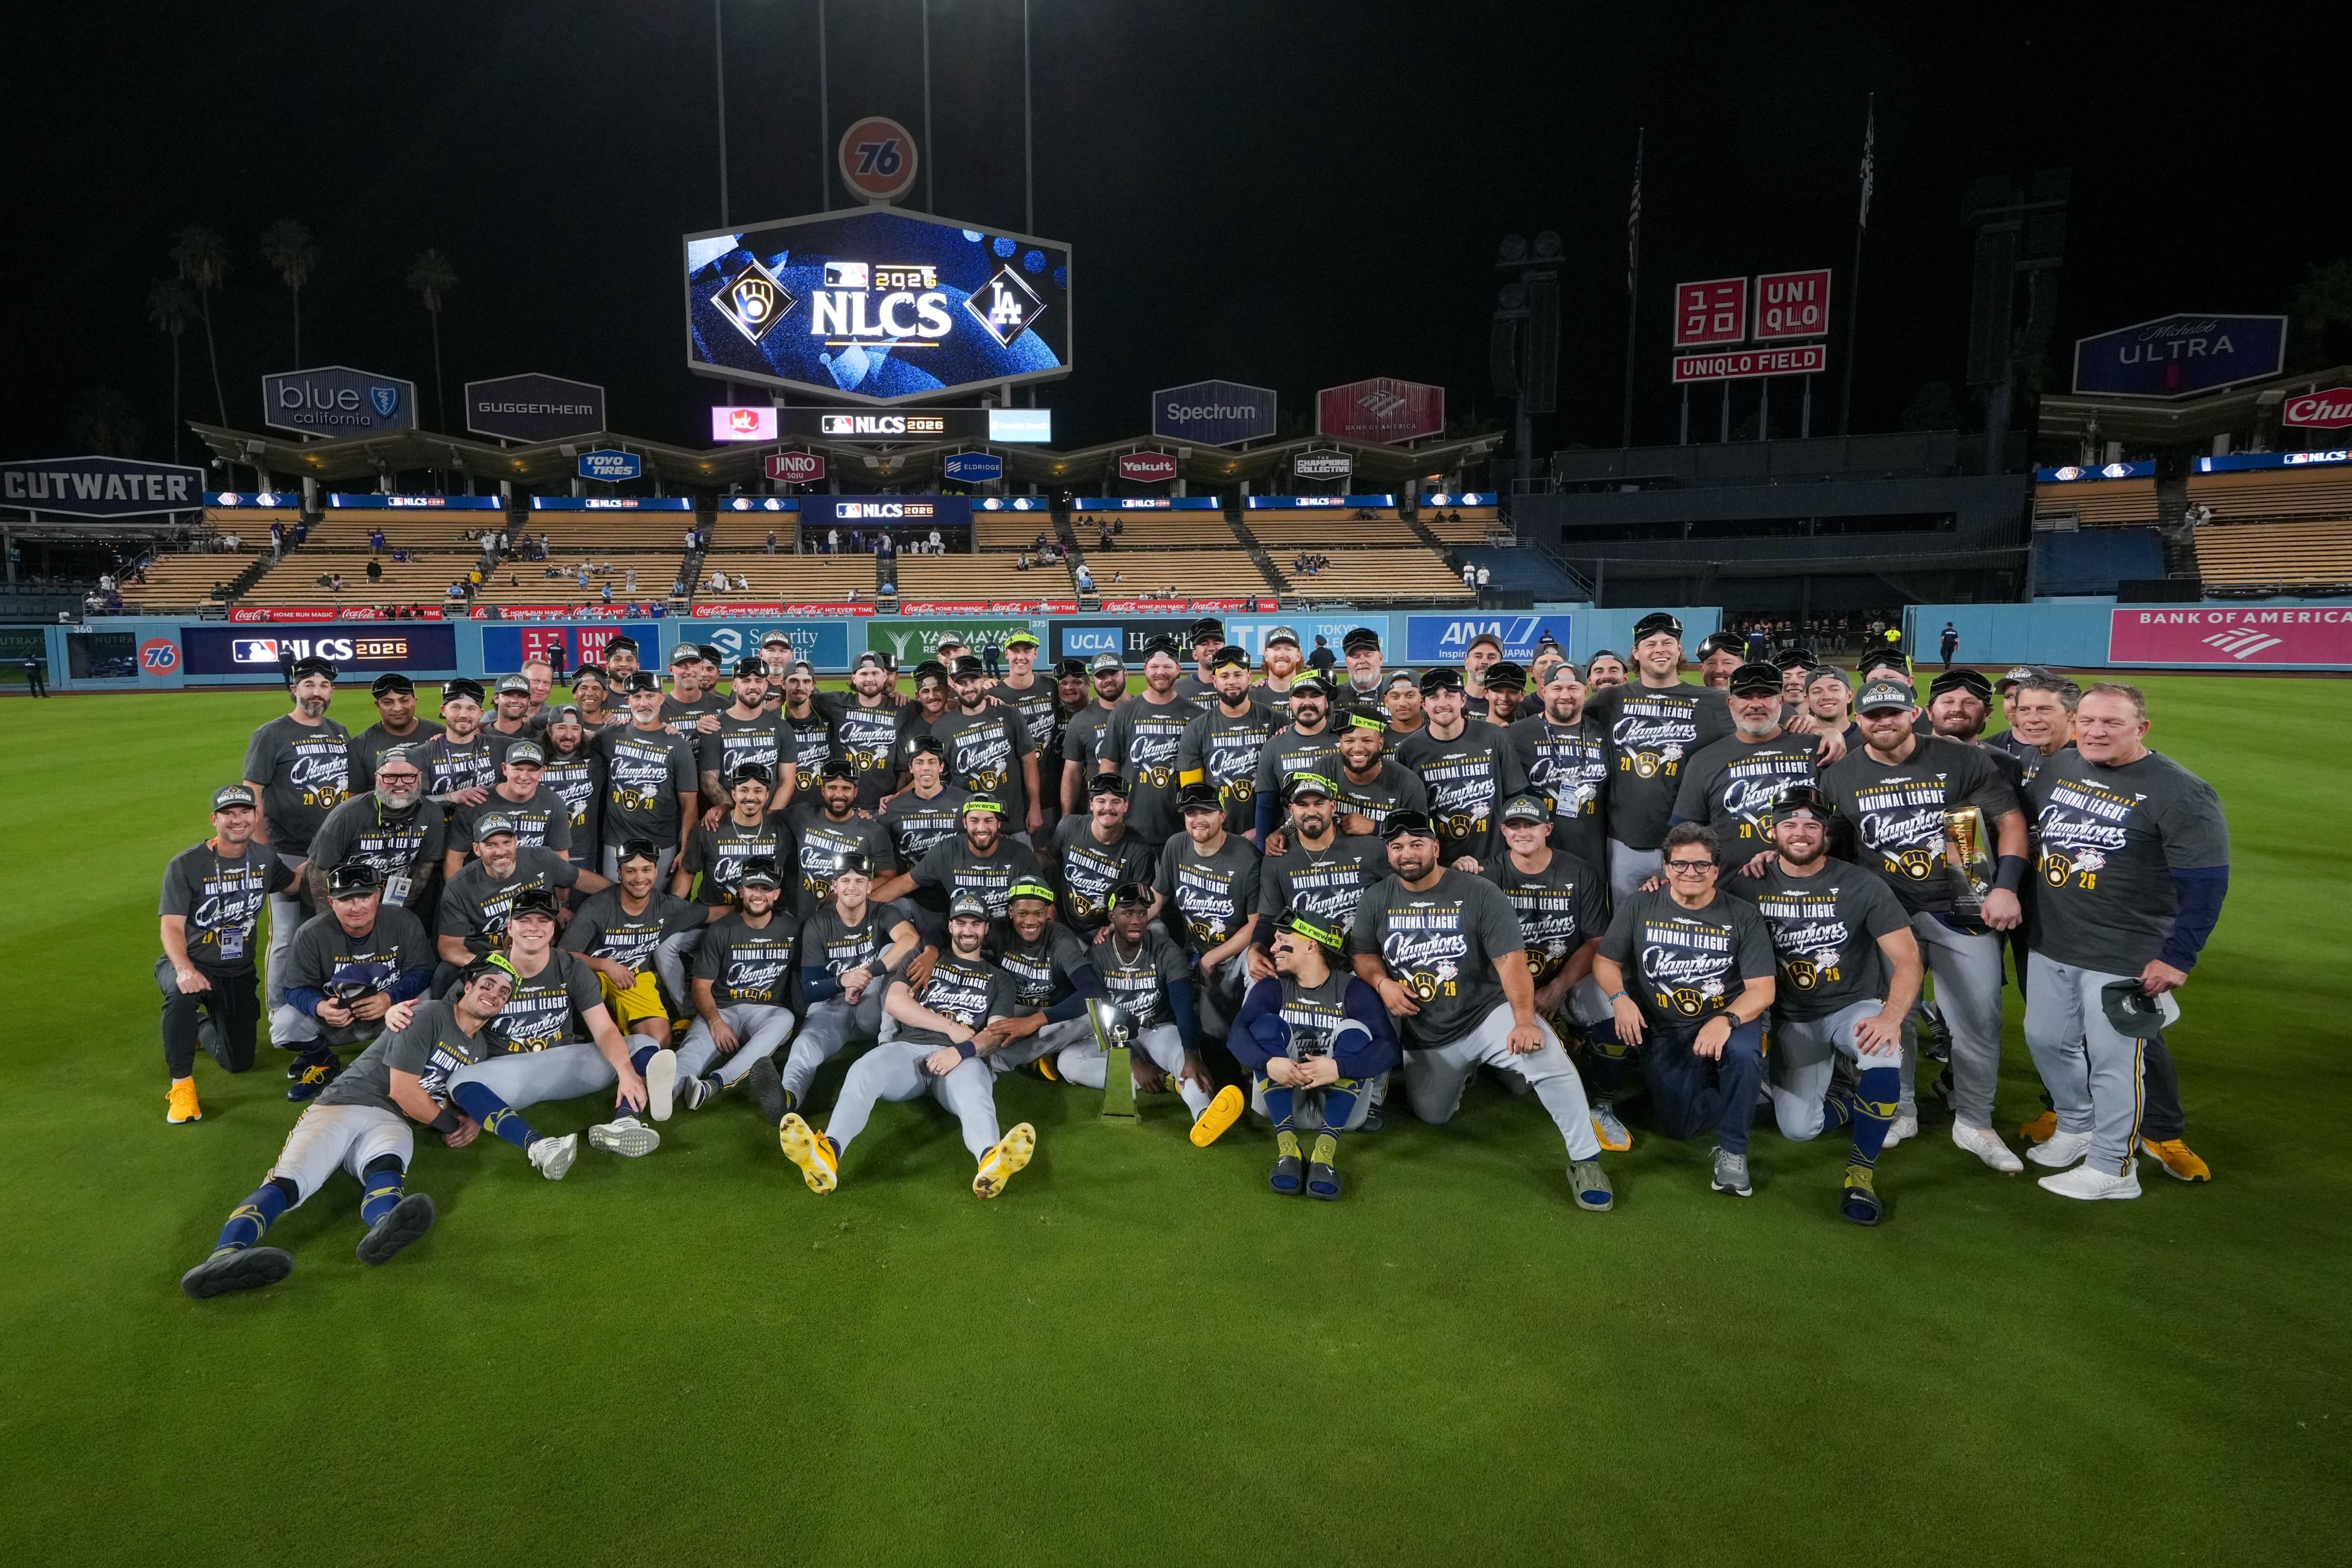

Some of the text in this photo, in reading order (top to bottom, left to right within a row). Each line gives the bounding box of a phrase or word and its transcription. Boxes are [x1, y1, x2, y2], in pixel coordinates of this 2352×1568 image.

[854, 138, 903, 176] 76
[1768, 280, 1815, 304] UNI
[811, 290, 952, 337] NLCS
[1766, 305, 1819, 332] QLO
[2139, 319, 2218, 342] Michelob
[2119, 335, 2234, 365] ULTRA
[1683, 350, 1817, 377] UNIQLO FIELD
[279, 379, 361, 410] blue
[478, 402, 593, 415] GUGGENHEIM
[1167, 403, 1256, 424] Spectrum
[294, 412, 370, 426] california
[855, 416, 944, 434] NLCS 2026
[586, 456, 624, 466] TOYO
[775, 457, 816, 475] JINRO
[2309, 451, 2346, 462] NLCS
[592, 466, 633, 475] TIRES
[1123, 462, 1174, 471] Yakult
[4, 470, 189, 502] CUTWATER
[863, 503, 903, 518] NLCS
[2139, 611, 2352, 624] BANK OF AMERICA
[356, 643, 408, 654] 2026
[1071, 634, 1115, 649] UCLA
[144, 645, 176, 668] 76
[1862, 693, 1905, 705] WORLD SERIES
[846, 710, 895, 726] NATIONAL LEAGUE
[1623, 704, 1694, 720] NATIONAL LEAGUE
[839, 722, 896, 747] Champions
[956, 727, 1005, 748] NATIONAL LEAGUE
[1613, 717, 1697, 747] Champions
[296, 744, 327, 755] NATIONAL
[614, 744, 668, 764] NATIONAL LEAGUE
[957, 739, 1011, 774] Champions
[610, 756, 668, 785] Champions
[1424, 763, 1490, 782] NATIONAL LEAGUE
[1621, 757, 1677, 776] 20 26
[1427, 778, 1495, 812] Champions
[1858, 789, 1945, 812] NATIONAL LEAGUE
[2049, 786, 2130, 821] NATIONAL LEAGUE
[1506, 807, 1539, 817] WORLD SERIES
[1477, 819, 1487, 832] 26
[1860, 808, 1946, 853] Champion
[2038, 804, 2127, 850] Champions
[1884, 859, 1896, 873] 20
[2079, 871, 2097, 890] 26
[1389, 915, 1459, 929] NATIONAL LEAGUE
[1646, 928, 1730, 951] NATIONAL LEAGUE
[733, 949, 790, 960] NATIONAL LEAGUE
[1384, 932, 1467, 968] Champions
[1642, 945, 1734, 984] Champions
[1444, 981, 1457, 997] 26
[1656, 993, 1668, 1009] 20
